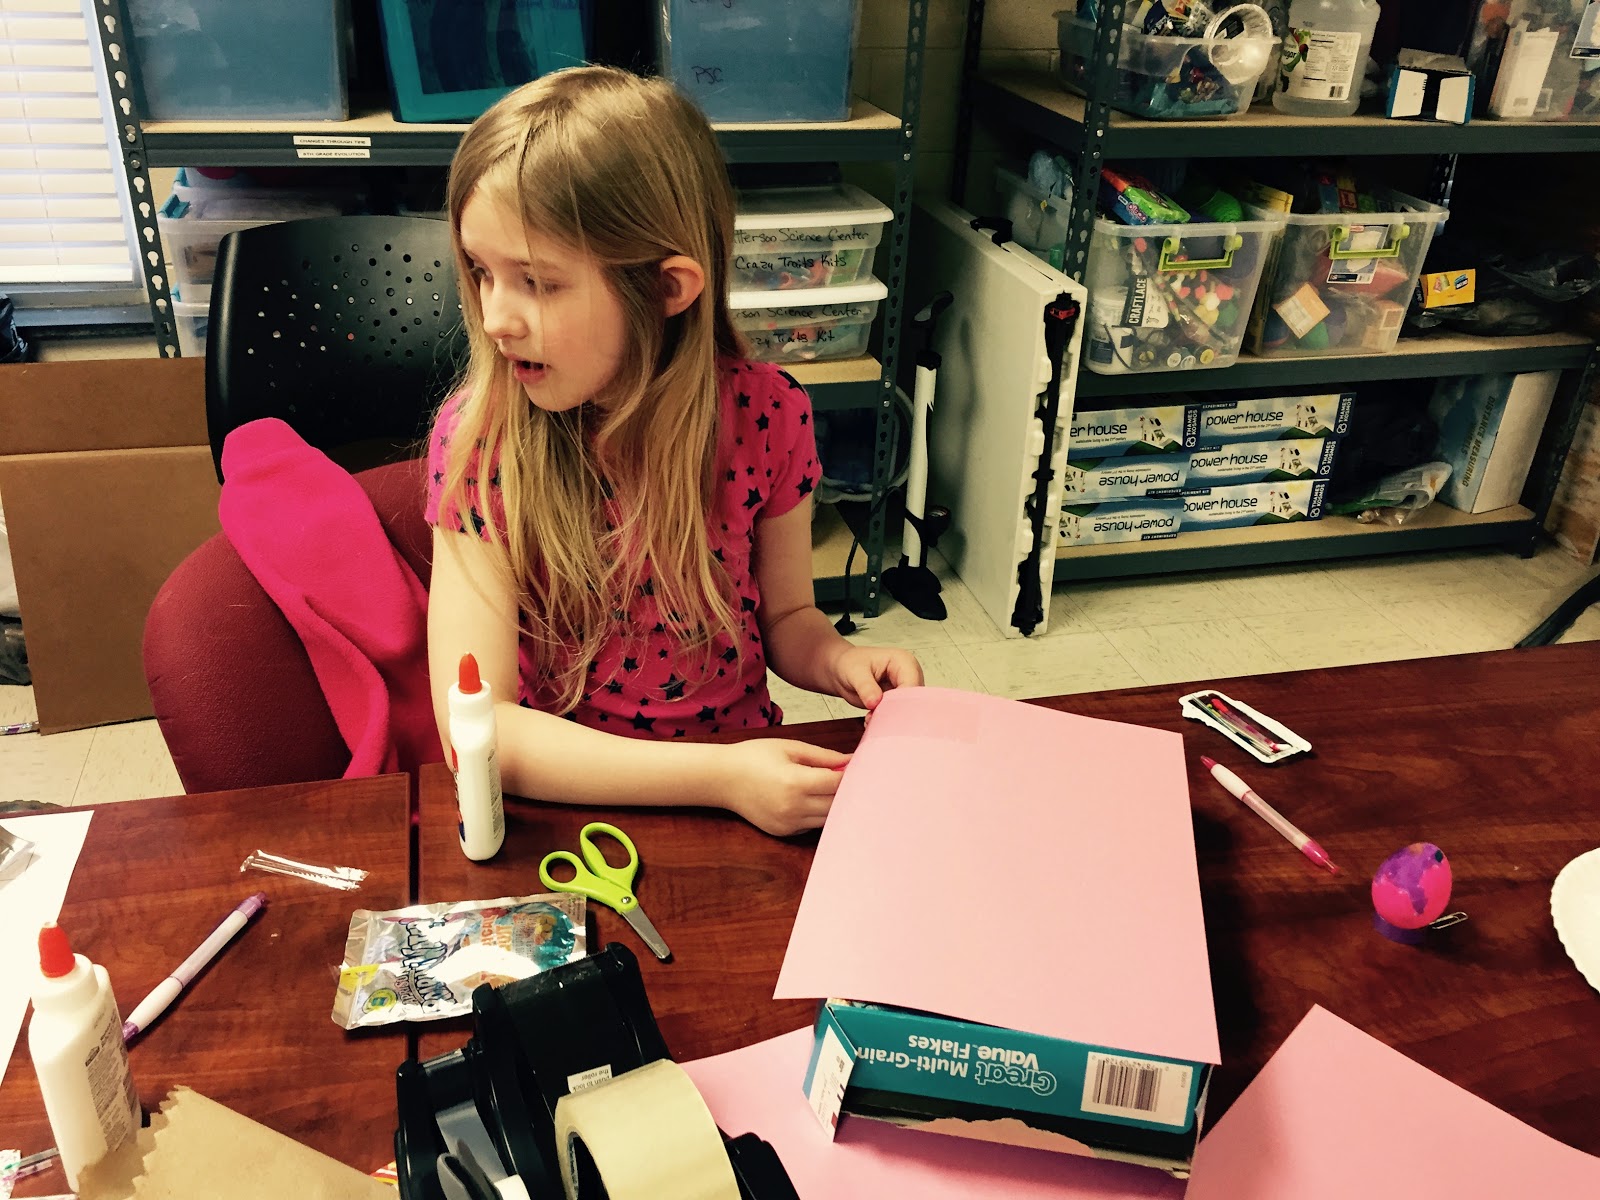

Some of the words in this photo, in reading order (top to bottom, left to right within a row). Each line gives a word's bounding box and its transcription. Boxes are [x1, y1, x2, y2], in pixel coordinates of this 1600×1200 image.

[691, 65, 724, 85] PSC
[778, 228, 823, 242] Science
[828, 228, 869, 241] Center
[735, 256, 773, 271] Crazy
[778, 256, 815, 269] Traits
[821, 254, 847, 267] Kits
[735, 310, 760, 319] rson
[767, 306, 814, 319] Science
[822, 304, 862, 317] Center
[1128, 278, 1147, 324] CRAFTLACE
[816, 330, 836, 343] Kit
[1205, 413, 1244, 429] power
[1245, 410, 1284, 423] house
[1339, 398, 1348, 423] THAMES
[1344, 397, 1353, 422] KOSMOS
[1478, 395, 1496, 438] DISTANCE
[1087, 423, 1127, 436] house
[1190, 457, 1229, 471] power
[1230, 453, 1268, 465] house
[1322, 441, 1331, 465] THAMES
[1327, 441, 1337, 464] KOSMOS
[1462, 438, 1482, 487] MEASURING
[1098, 475, 1138, 487] house
[1140, 470, 1180, 484] power
[1220, 497, 1258, 509] house
[1312, 484, 1320, 508] THAMES
[1317, 483, 1325, 507] KOSMOS
[1094, 521, 1133, 532] house
[1134, 516, 1174, 529] power
[908, 1034, 970, 1060] Flakes
[978, 1045, 1039, 1070] Value
[857, 1046, 969, 1078] Multi-Grain
[974, 1061, 1057, 1097] Great
